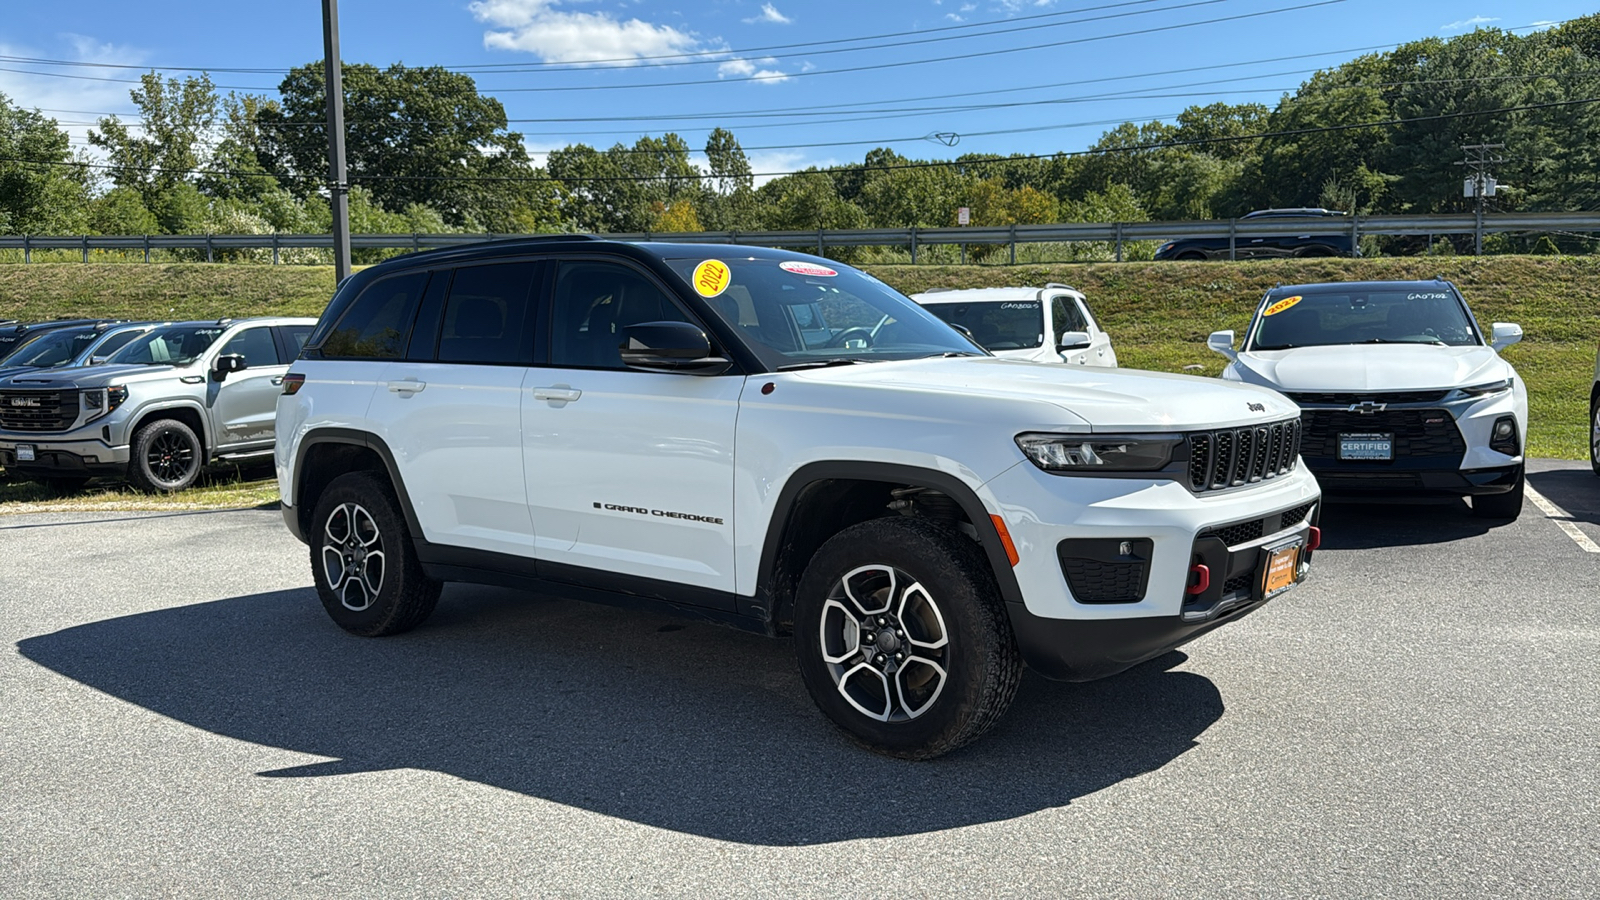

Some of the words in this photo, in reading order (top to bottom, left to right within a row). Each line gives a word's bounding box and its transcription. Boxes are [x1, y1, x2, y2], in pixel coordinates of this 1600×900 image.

[700, 263, 724, 292] 2022
[1268, 297, 1300, 315] 2022
[11, 397, 41, 407] GMC
[1246, 402, 1265, 412] Jeep
[604, 503, 648, 515] GRAND
[651, 509, 723, 525] CHEROKEE
